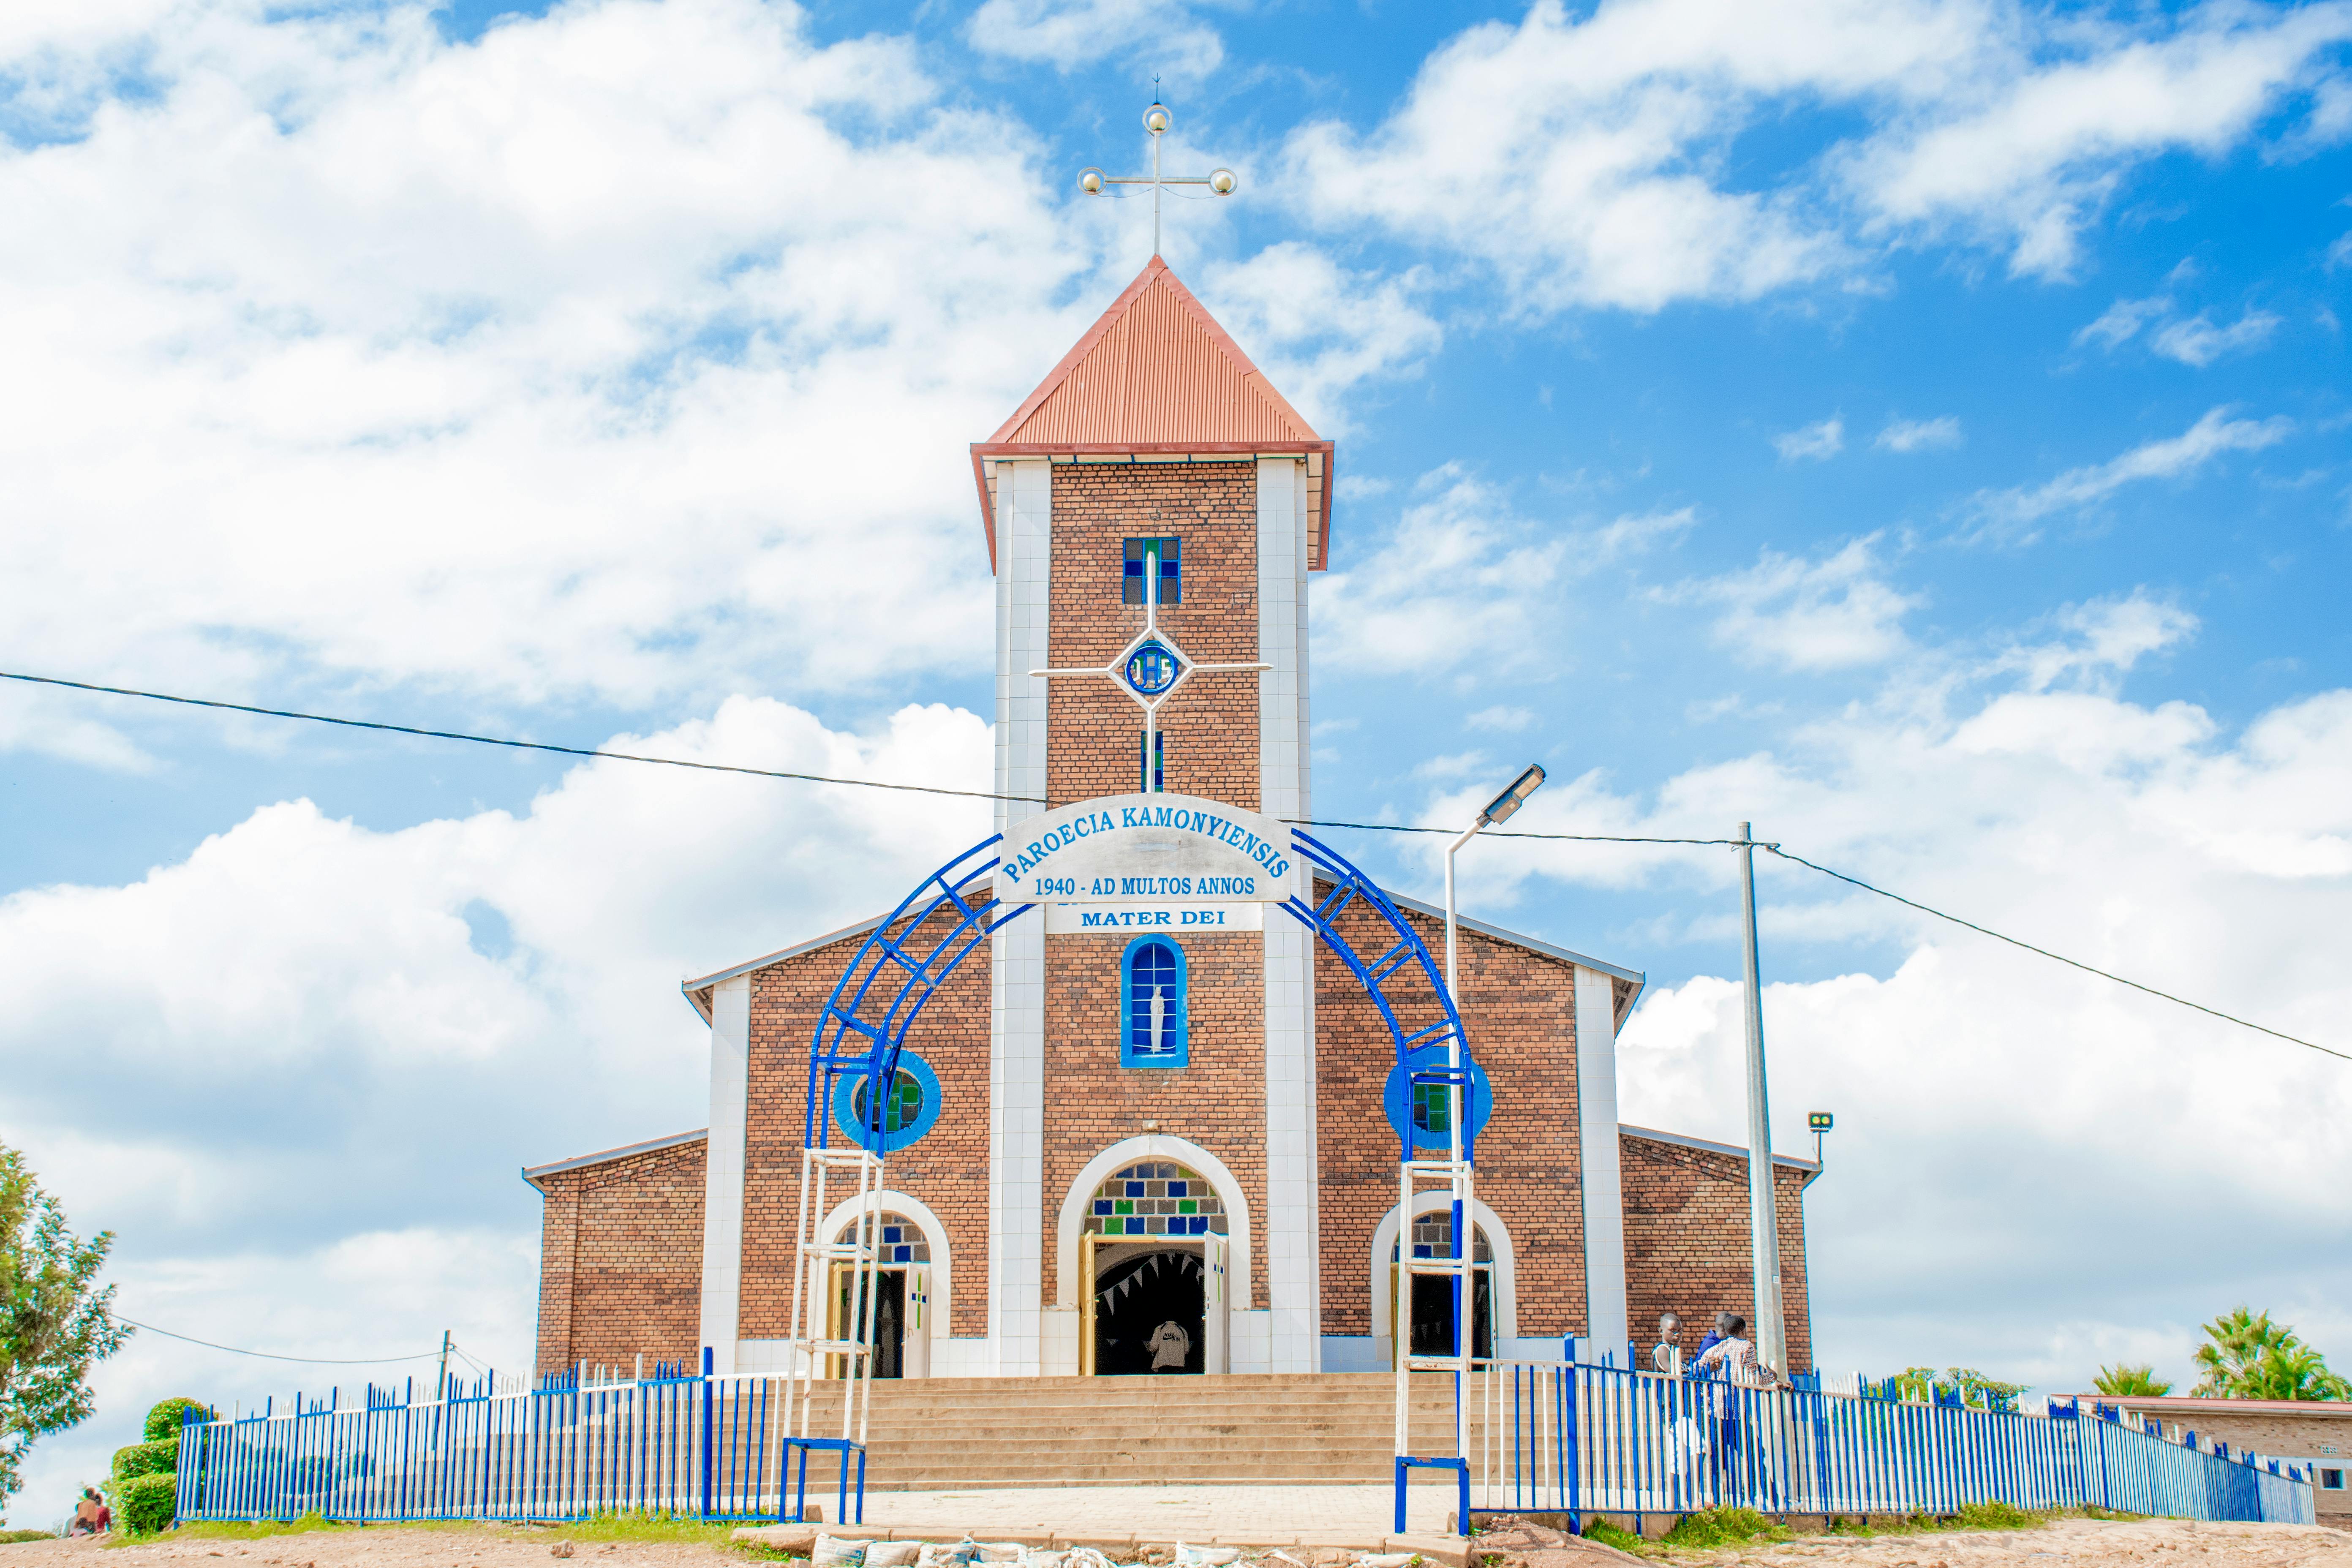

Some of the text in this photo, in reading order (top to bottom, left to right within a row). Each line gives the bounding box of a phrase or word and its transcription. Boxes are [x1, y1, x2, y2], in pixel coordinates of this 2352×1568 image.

[1002, 807, 1290, 883] PAROECIA KAMONYIENSIS
[1035, 878, 1075, 895] 1940
[1091, 878, 1116, 895] AD
[1122, 877, 1191, 895] MULTOS
[1196, 877, 1255, 895] ANNOS
[1081, 911, 1225, 926] MATER DEI
